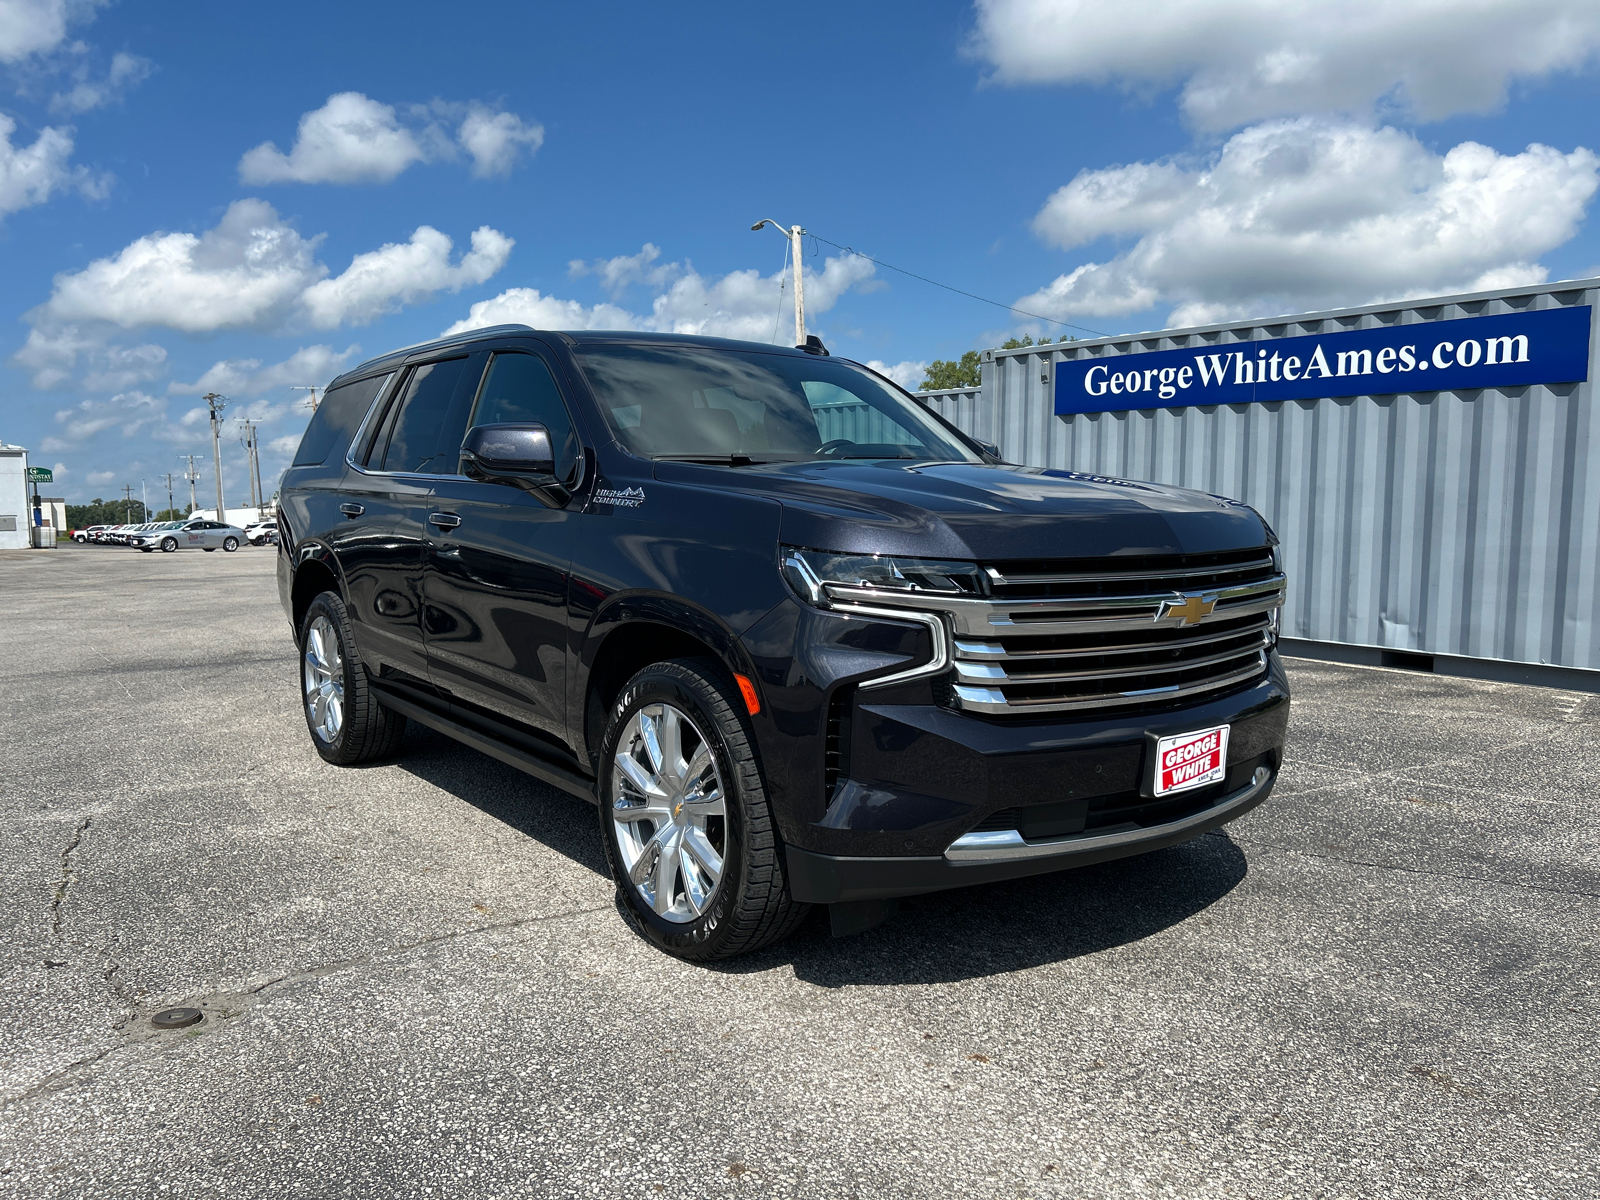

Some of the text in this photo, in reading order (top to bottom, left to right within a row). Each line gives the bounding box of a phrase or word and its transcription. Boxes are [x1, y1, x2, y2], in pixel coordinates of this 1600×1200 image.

[1083, 332, 1530, 399] GeorgeWhiteAmes.com
[592, 496, 643, 508] COUNTRY
[596, 489, 621, 498] HIGH
[1165, 734, 1218, 767] GEORGE
[1172, 755, 1212, 785] WHITE
